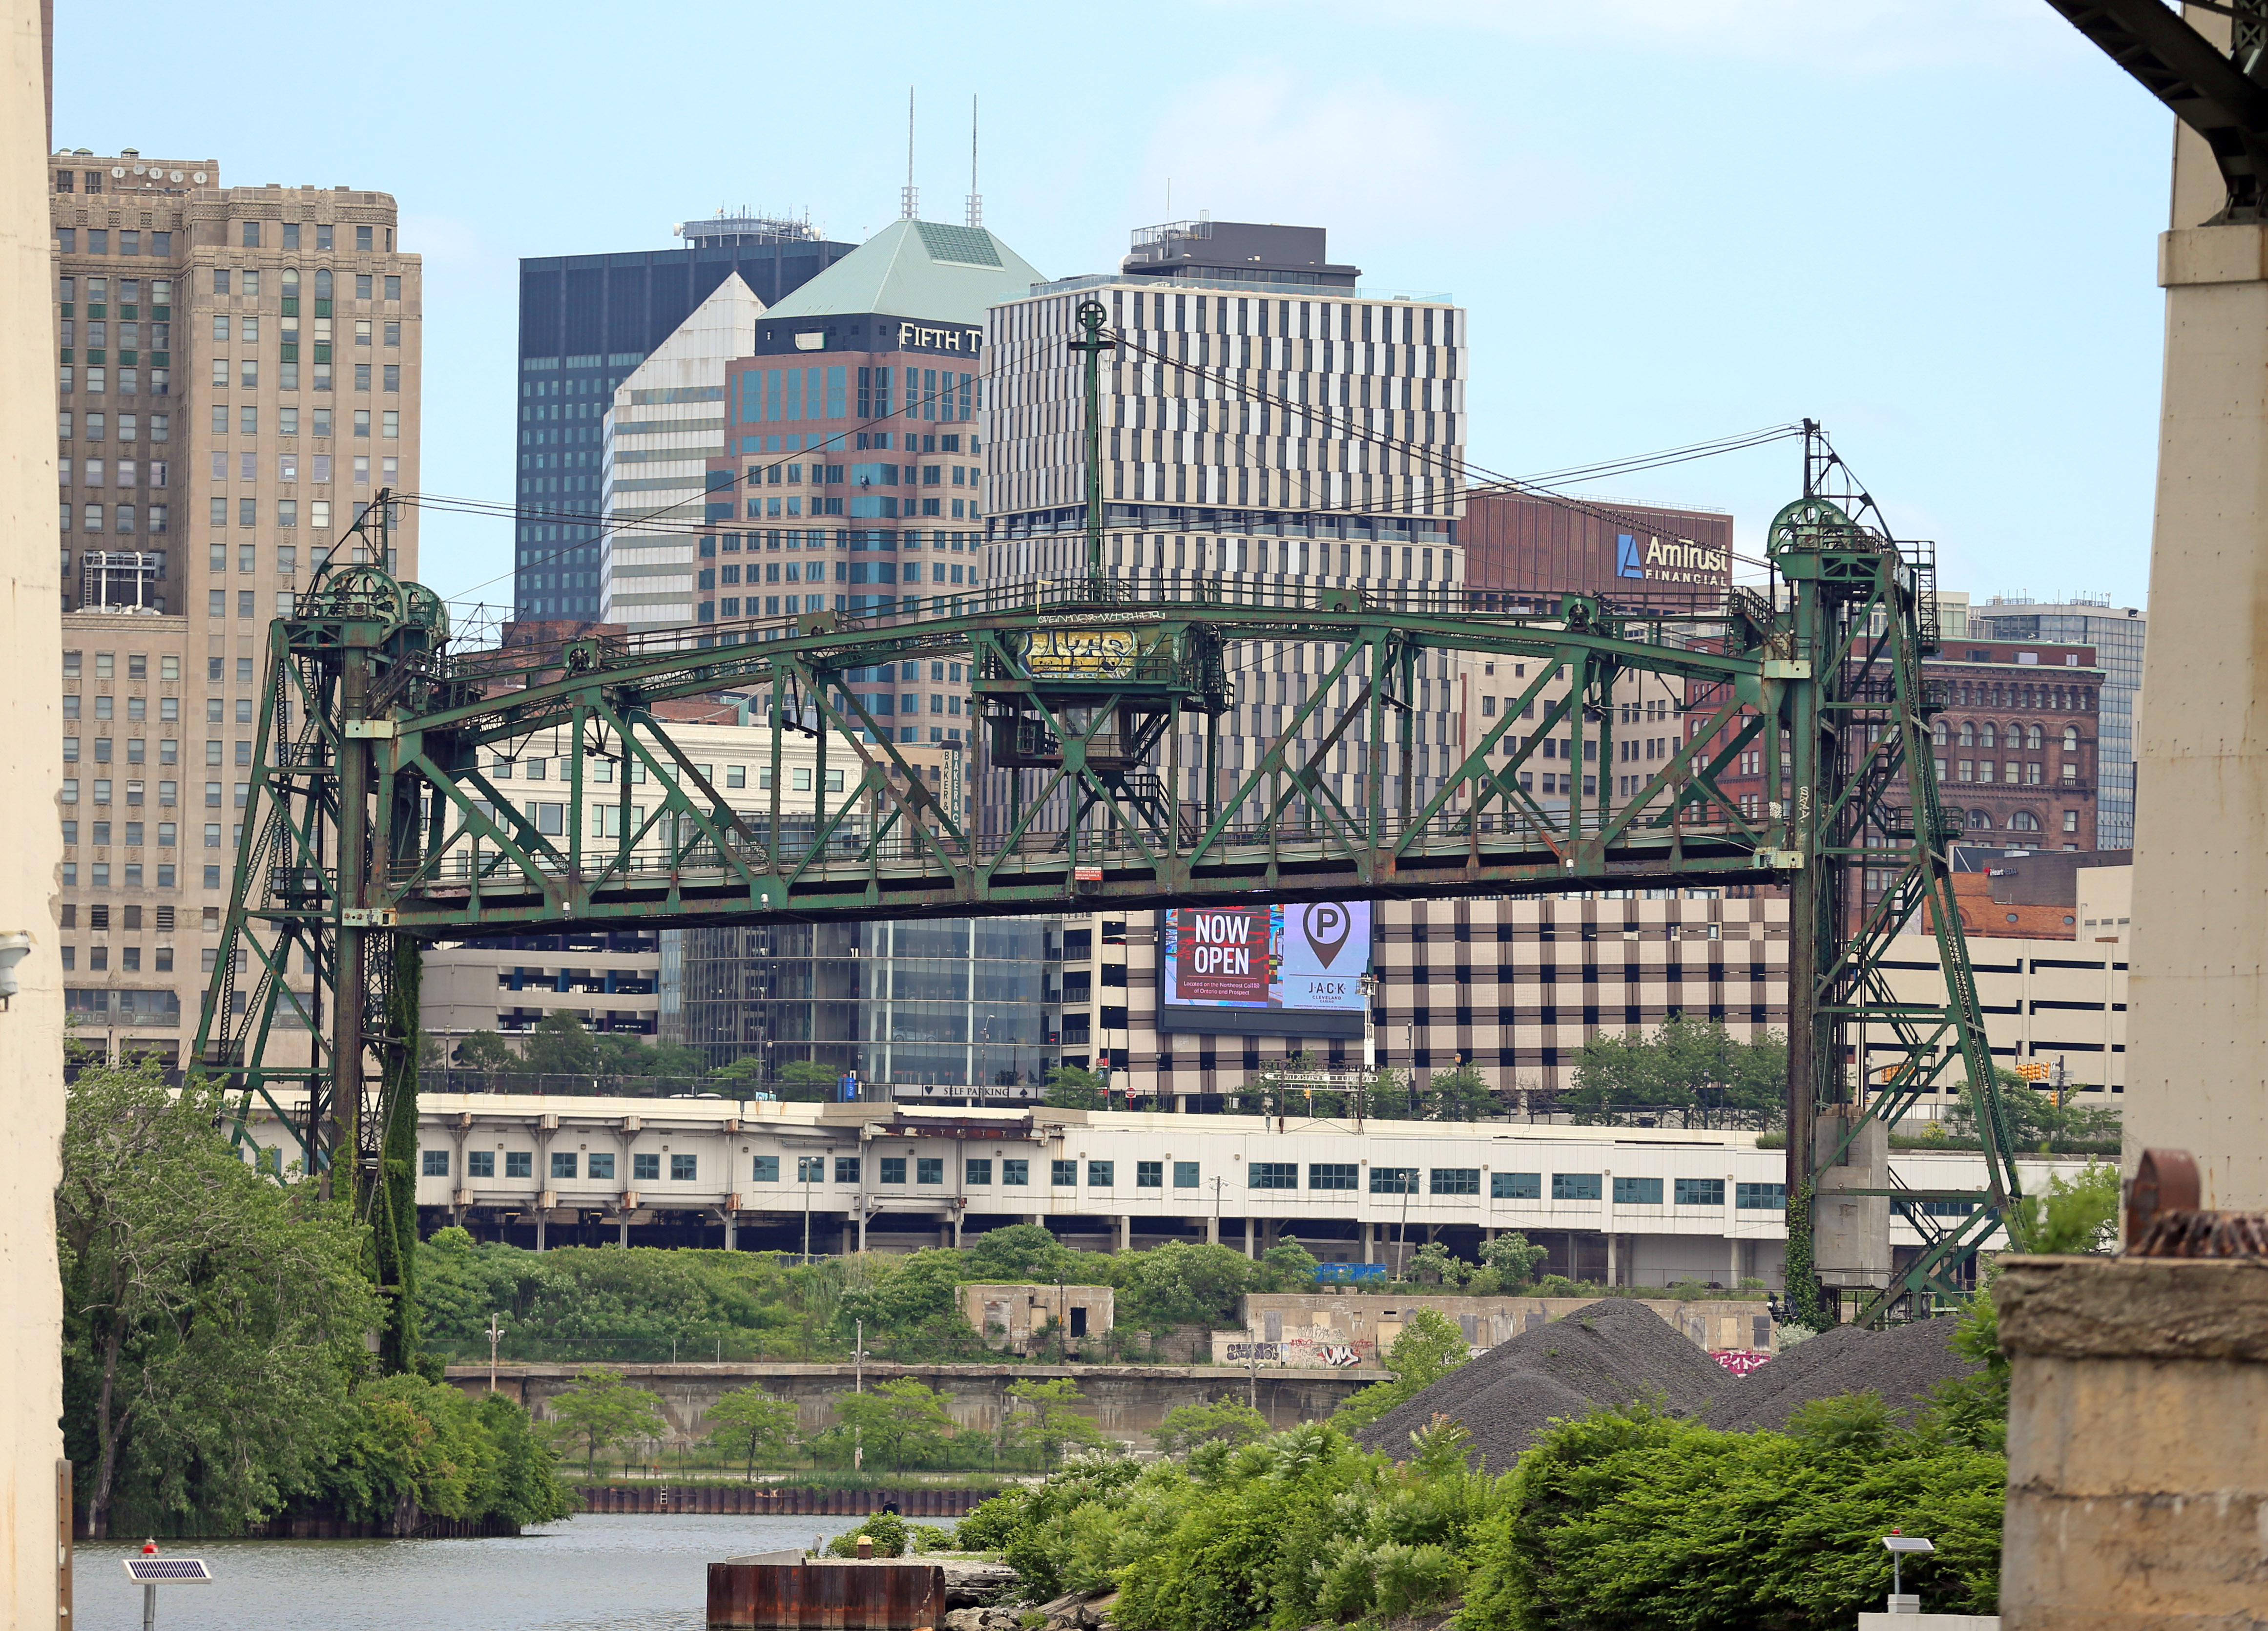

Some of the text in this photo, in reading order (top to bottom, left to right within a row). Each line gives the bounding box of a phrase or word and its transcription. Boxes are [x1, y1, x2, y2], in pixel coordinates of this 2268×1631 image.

[900, 322, 982, 352] FIFTH T
[1645, 536, 1727, 572] AmTrust
[1645, 569, 1727, 586] FINANCIAL
[943, 801, 949, 811] &
[954, 801, 959, 811] &
[1195, 914, 1251, 944] NOW
[1194, 946, 1249, 975] OPEN
[944, 1087, 964, 1095] SELF
